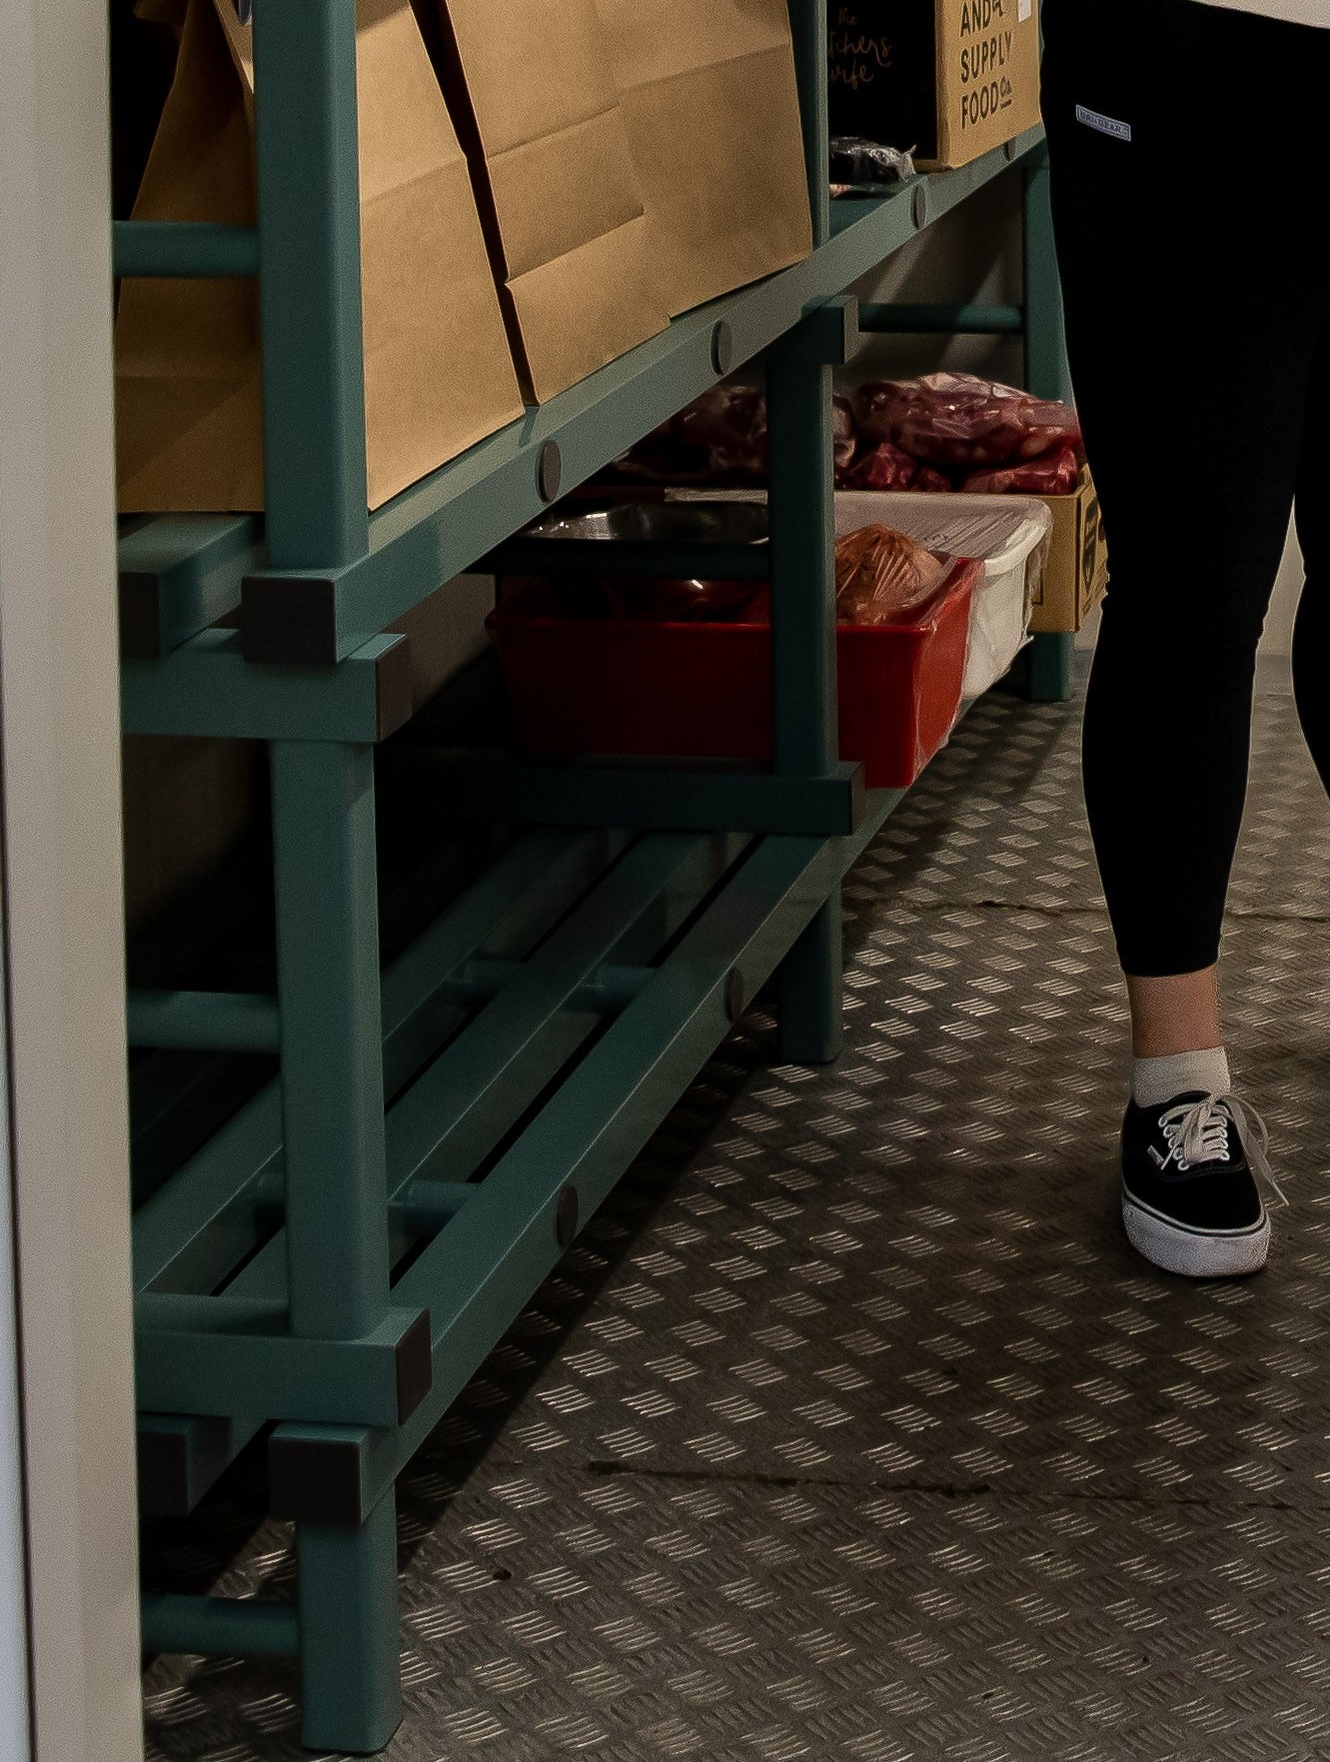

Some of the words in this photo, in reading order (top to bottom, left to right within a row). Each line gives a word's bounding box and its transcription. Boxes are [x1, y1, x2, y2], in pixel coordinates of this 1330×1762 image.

[828, 28, 894, 68] tchers
[961, 30, 1012, 85] SUPPLY
[961, 81, 999, 130] FOOD
